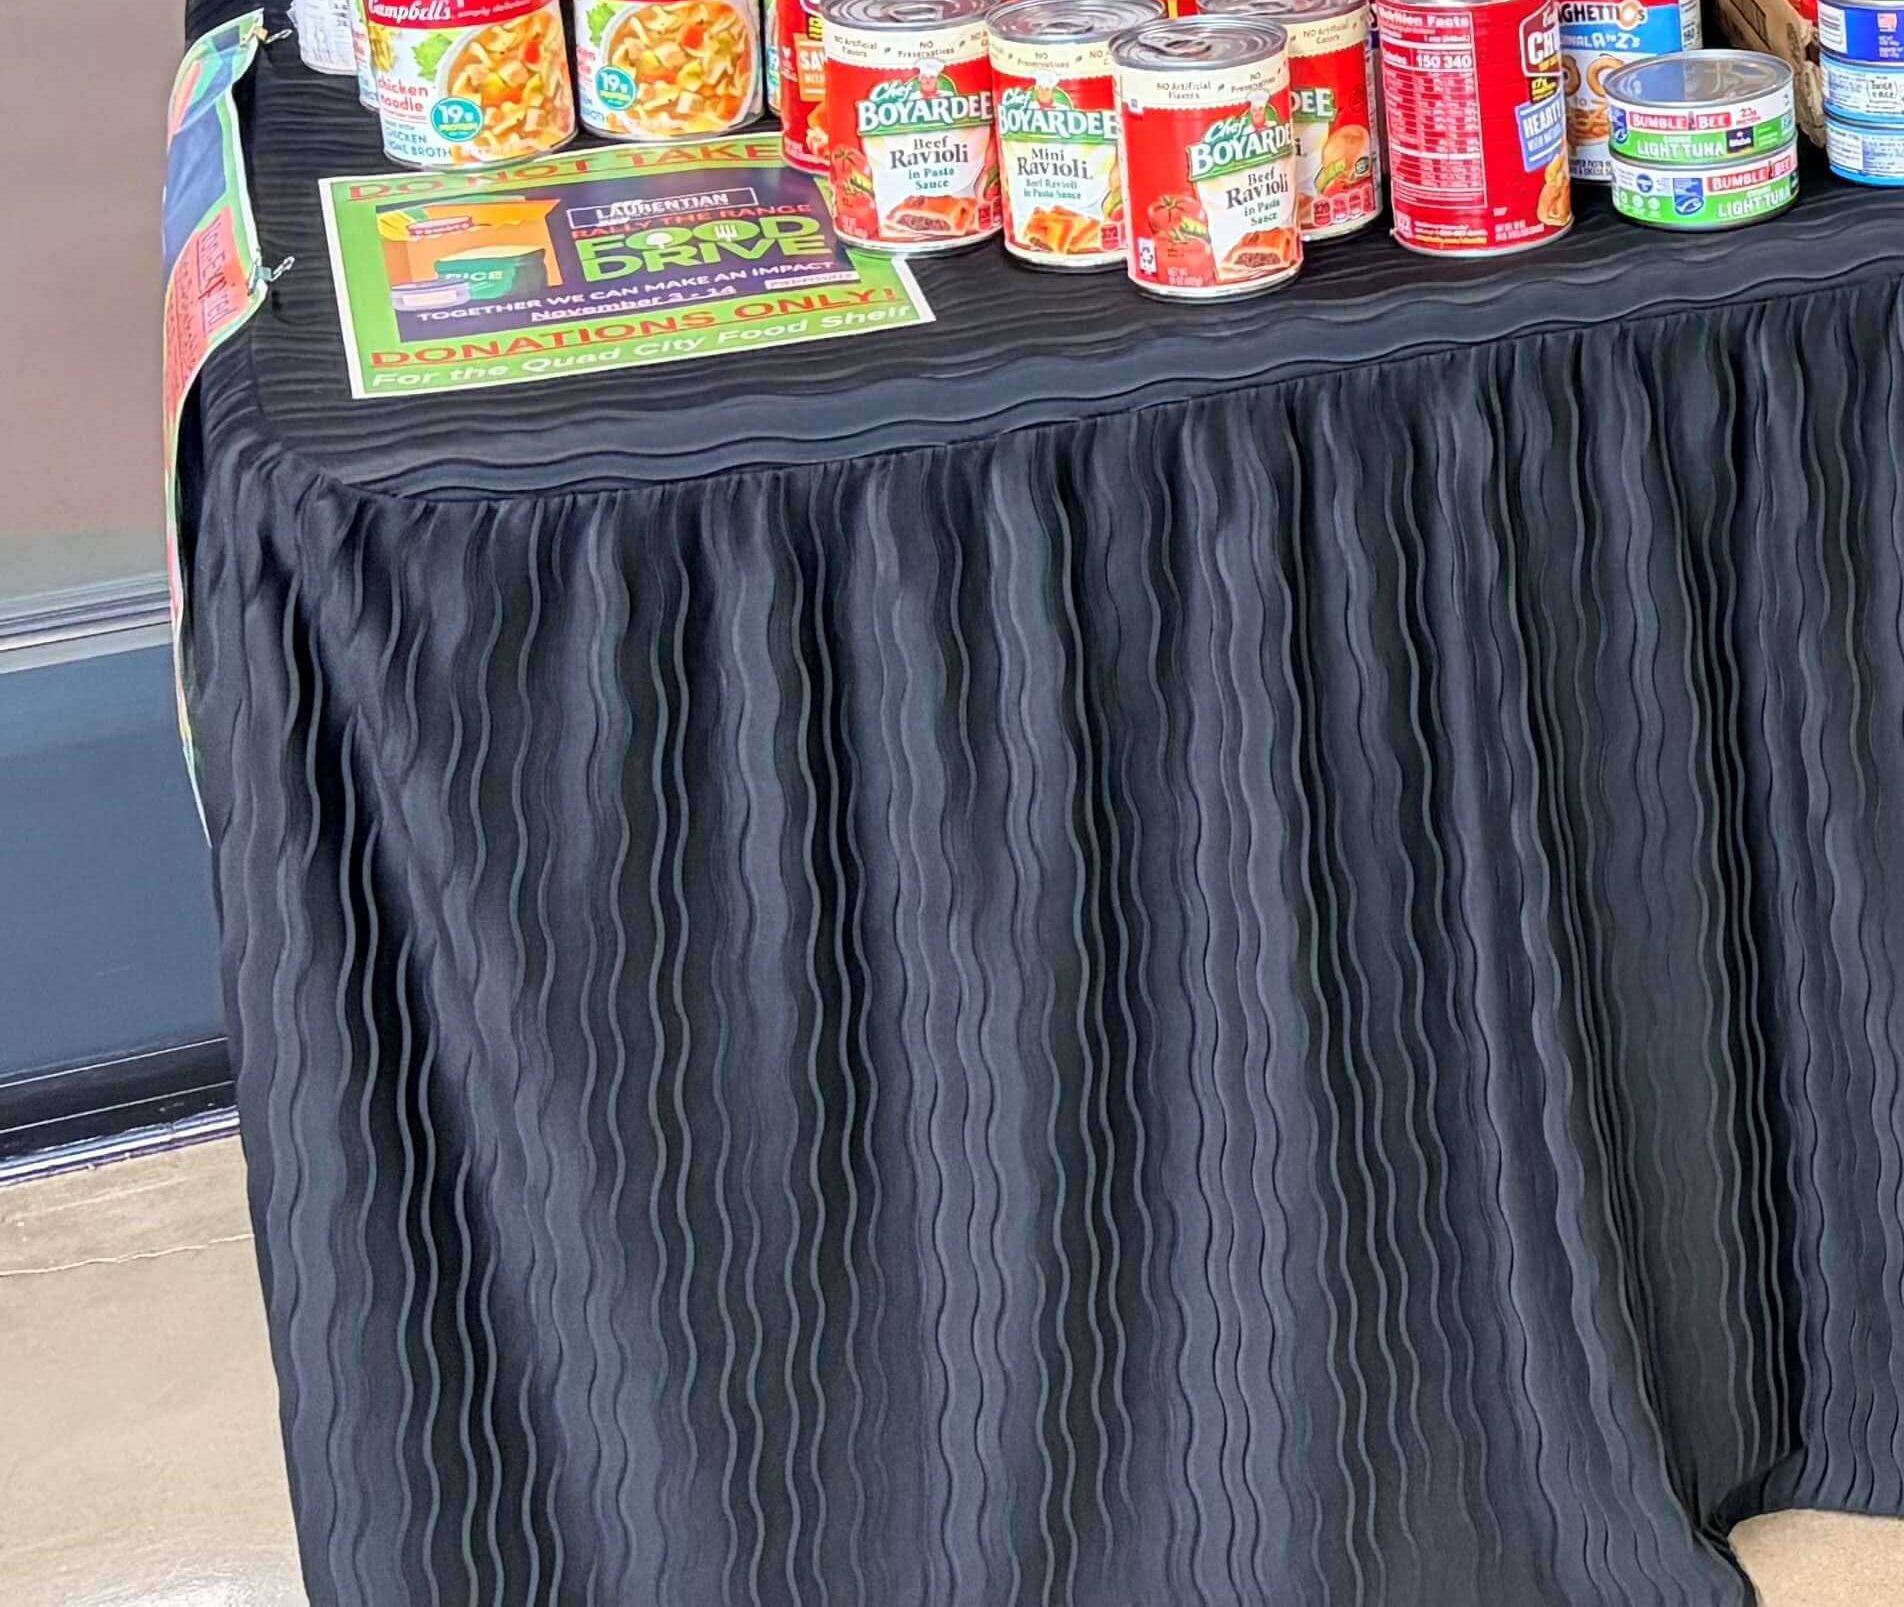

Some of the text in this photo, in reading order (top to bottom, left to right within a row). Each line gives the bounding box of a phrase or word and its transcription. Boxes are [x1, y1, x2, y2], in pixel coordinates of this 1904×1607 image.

[857, 92, 993, 132] BOYARDEE
[1630, 114, 1729, 130] BUMBLE BEE
[913, 136, 949, 150] Beef
[1030, 146, 1065, 161] Mini
[1637, 140, 1724, 156] LIGHT TUNA
[890, 145, 969, 170] Ravioli
[1016, 156, 1089, 179] Ravioli
[576, 214, 820, 259] FOOD
[579, 235, 833, 283] DRIVE
[370, 288, 898, 366] DONATIONS ONLY!
